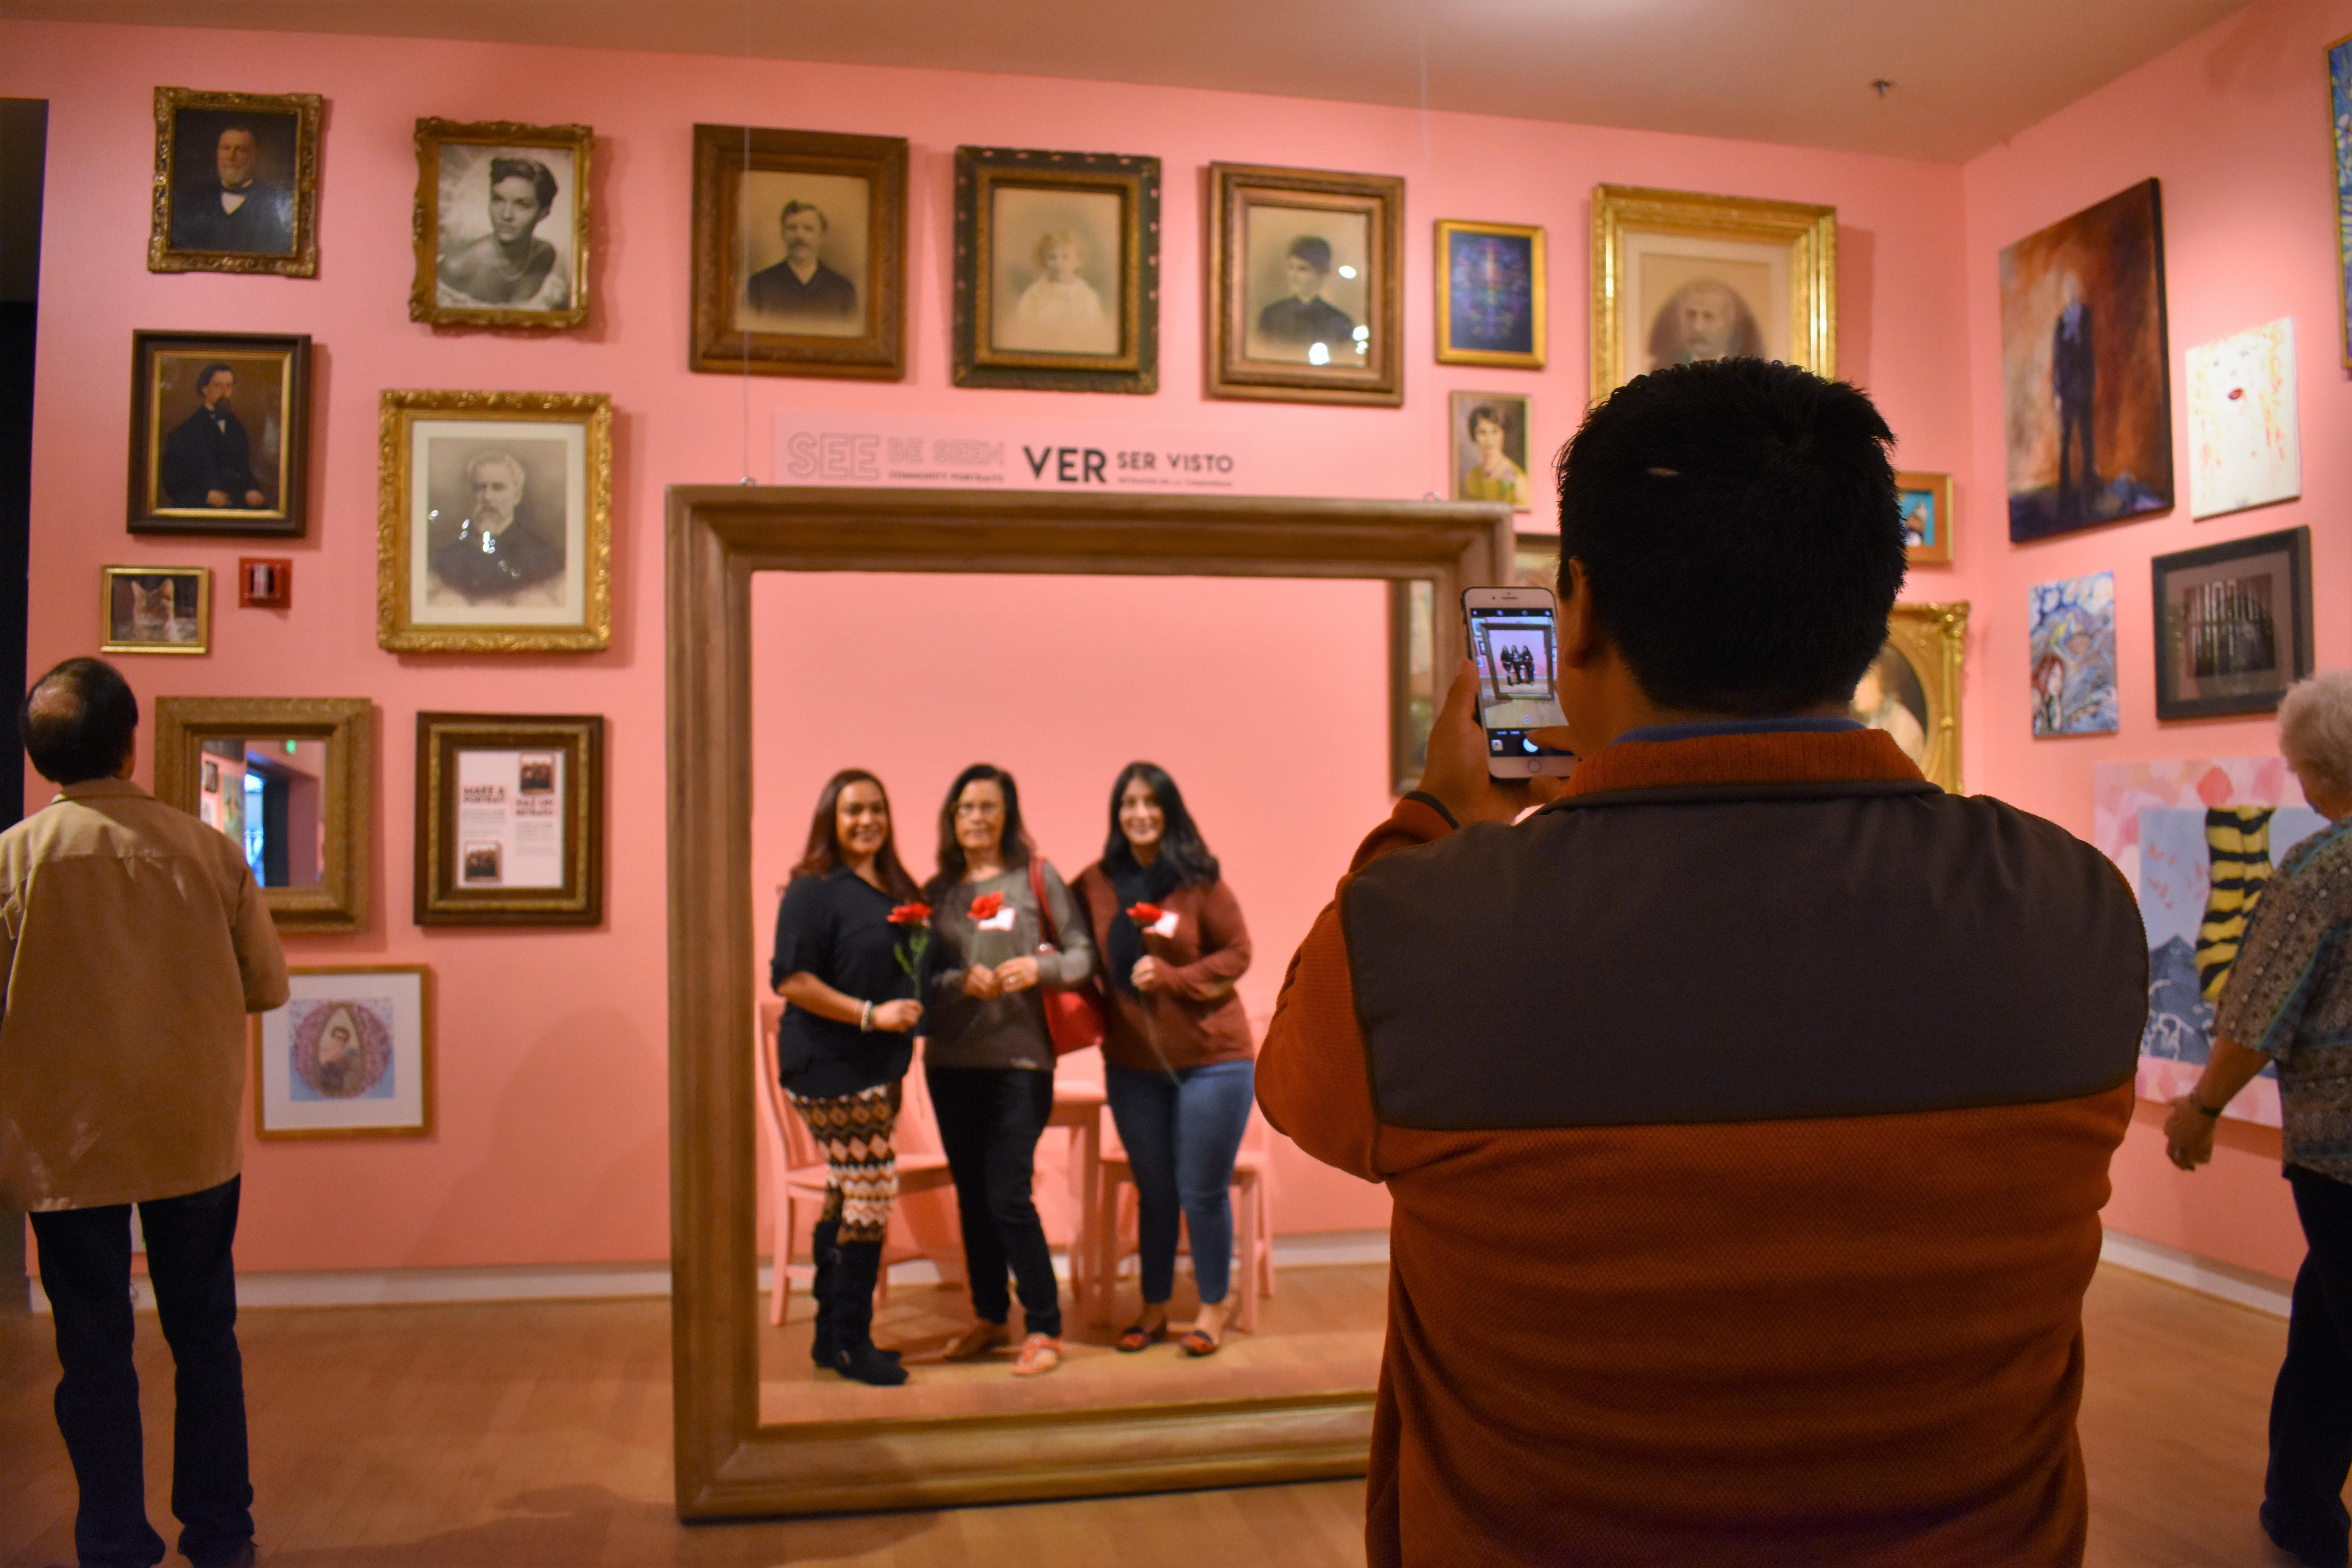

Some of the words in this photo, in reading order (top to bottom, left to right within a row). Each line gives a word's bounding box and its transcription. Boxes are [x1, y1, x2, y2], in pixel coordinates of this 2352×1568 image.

[787, 431, 881, 481] SEE
[887, 436, 924, 464] BE
[933, 439, 1005, 466] SEEN
[1022, 445, 1108, 484] VER
[1116, 451, 1156, 470] SER
[1167, 453, 1234, 473] VISTO
